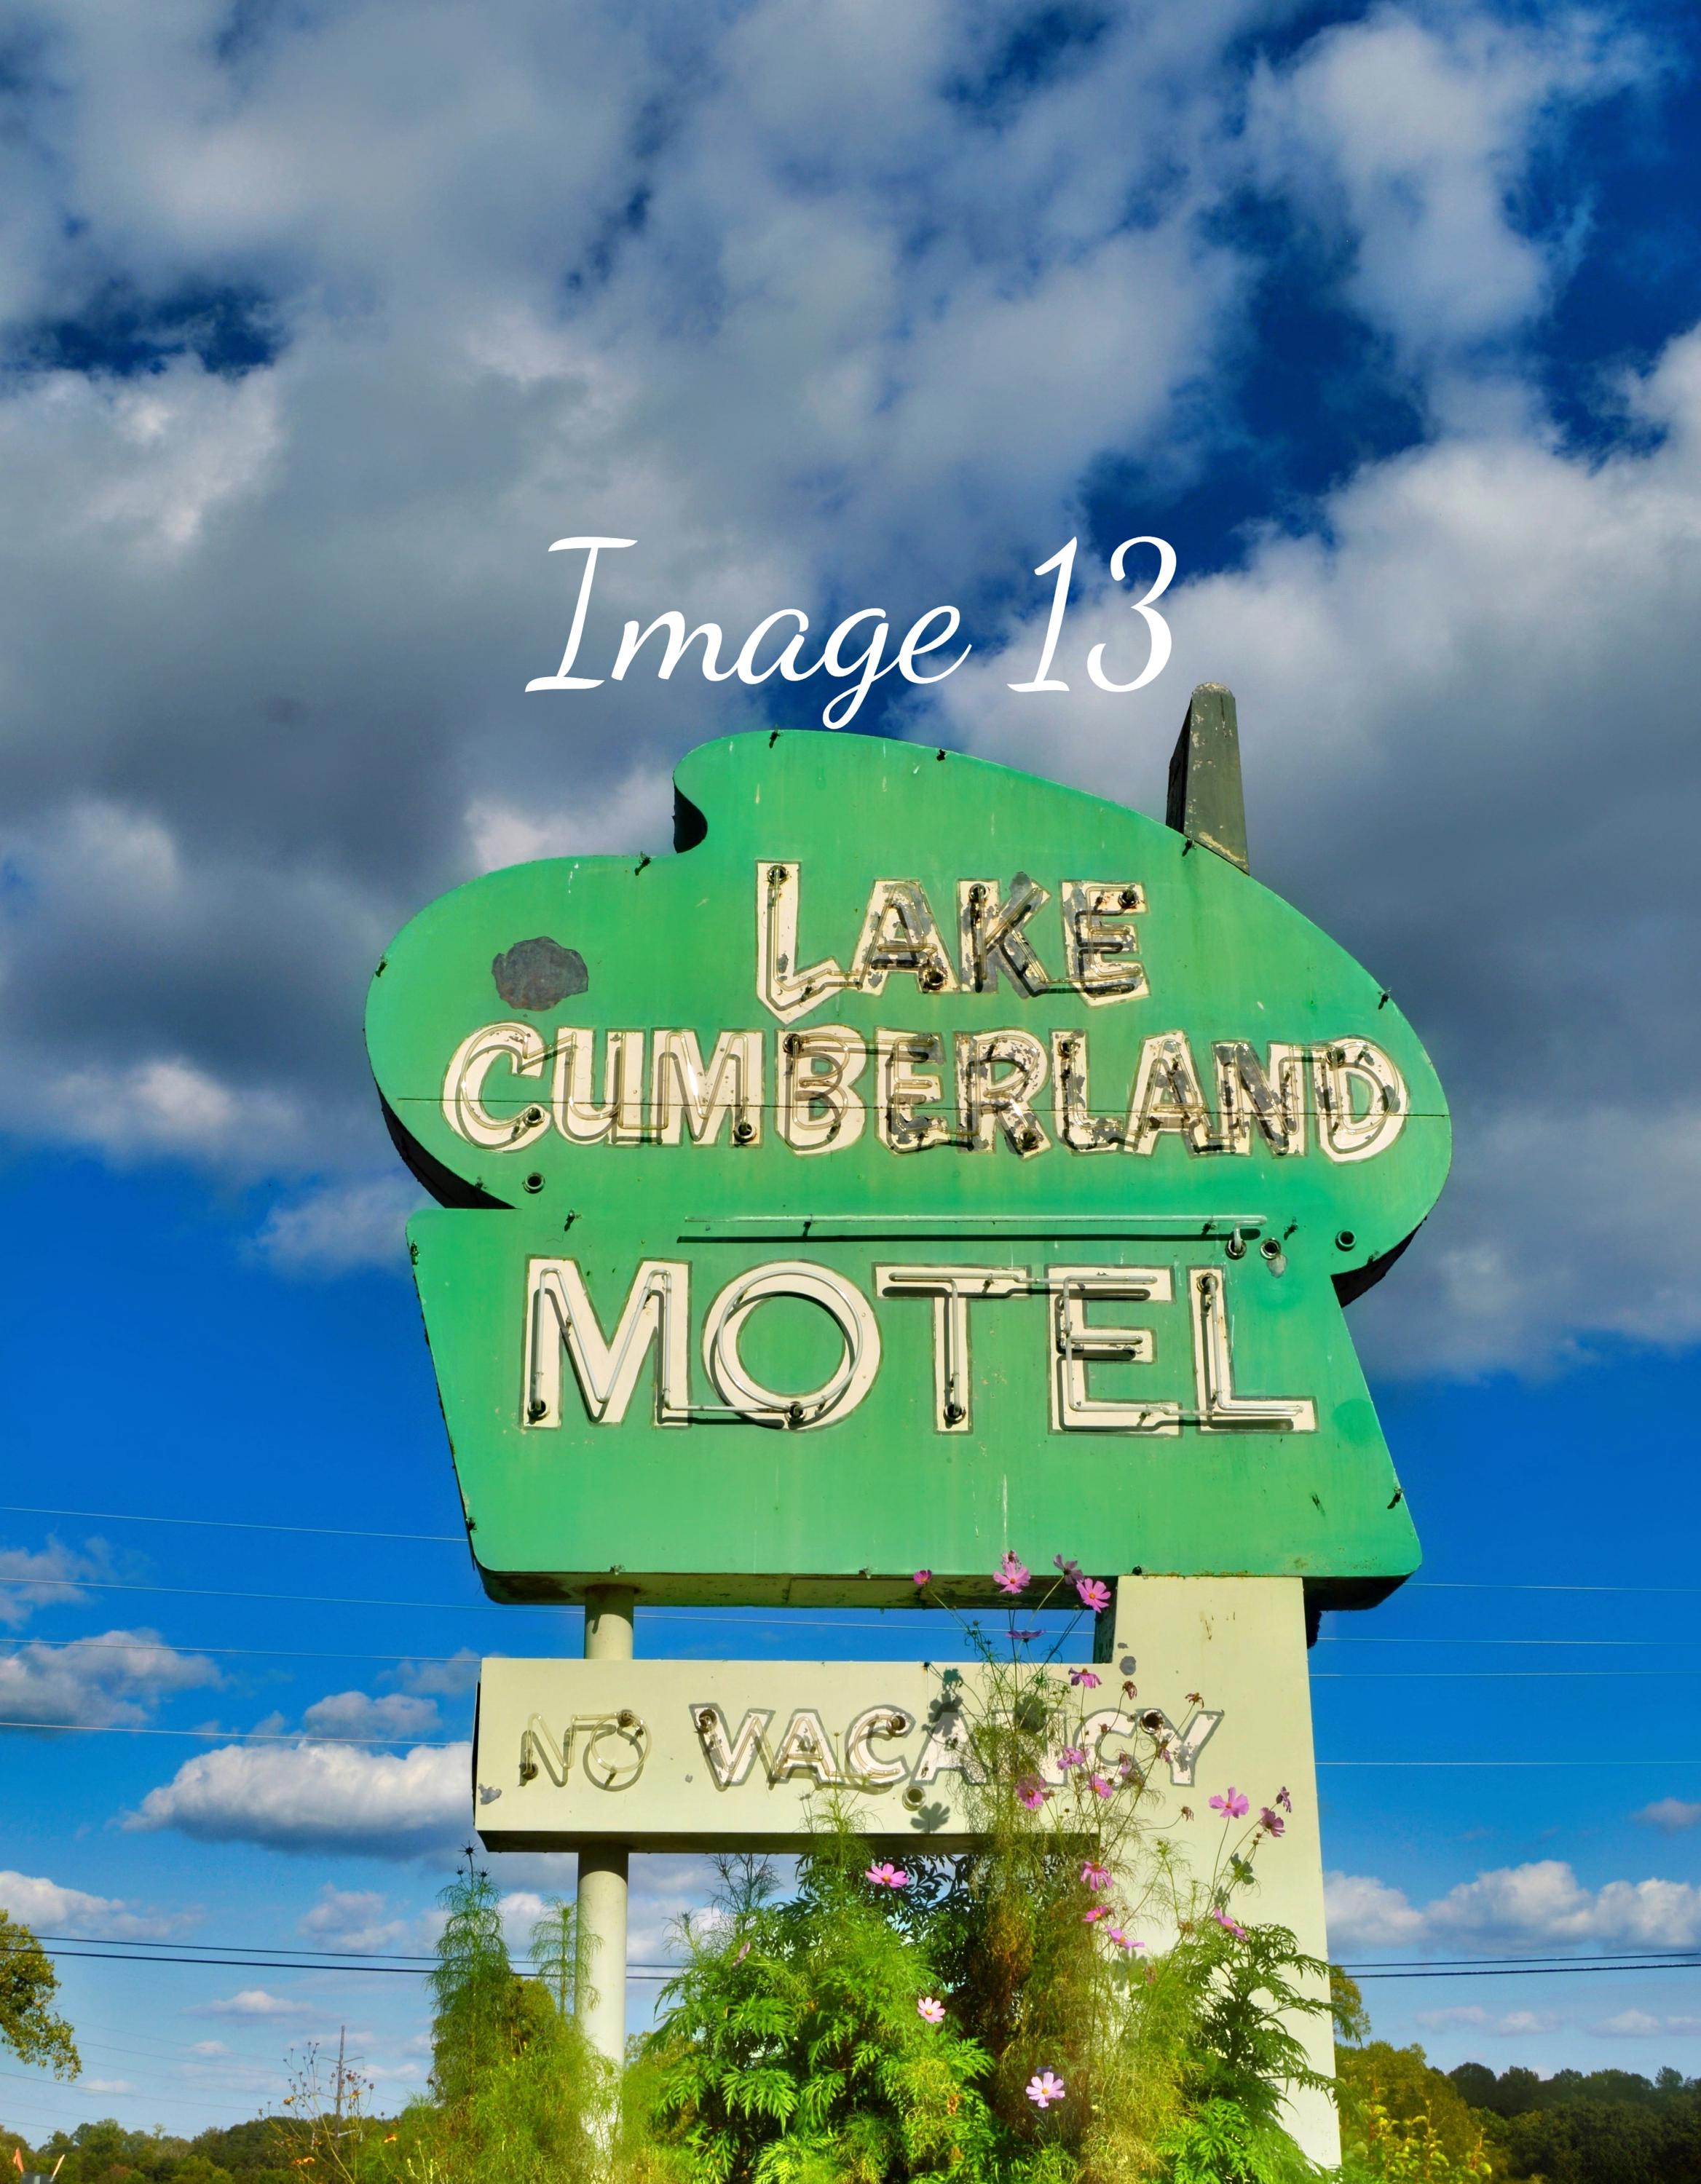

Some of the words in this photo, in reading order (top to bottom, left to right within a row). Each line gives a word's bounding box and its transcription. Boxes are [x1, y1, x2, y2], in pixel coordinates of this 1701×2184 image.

[755, 860, 1149, 1021] LAKE
[441, 1021, 1409, 1163] CUMBERLAND
[523, 1255, 1317, 1434] MOTEL
[521, 1712, 652, 1791] NO
